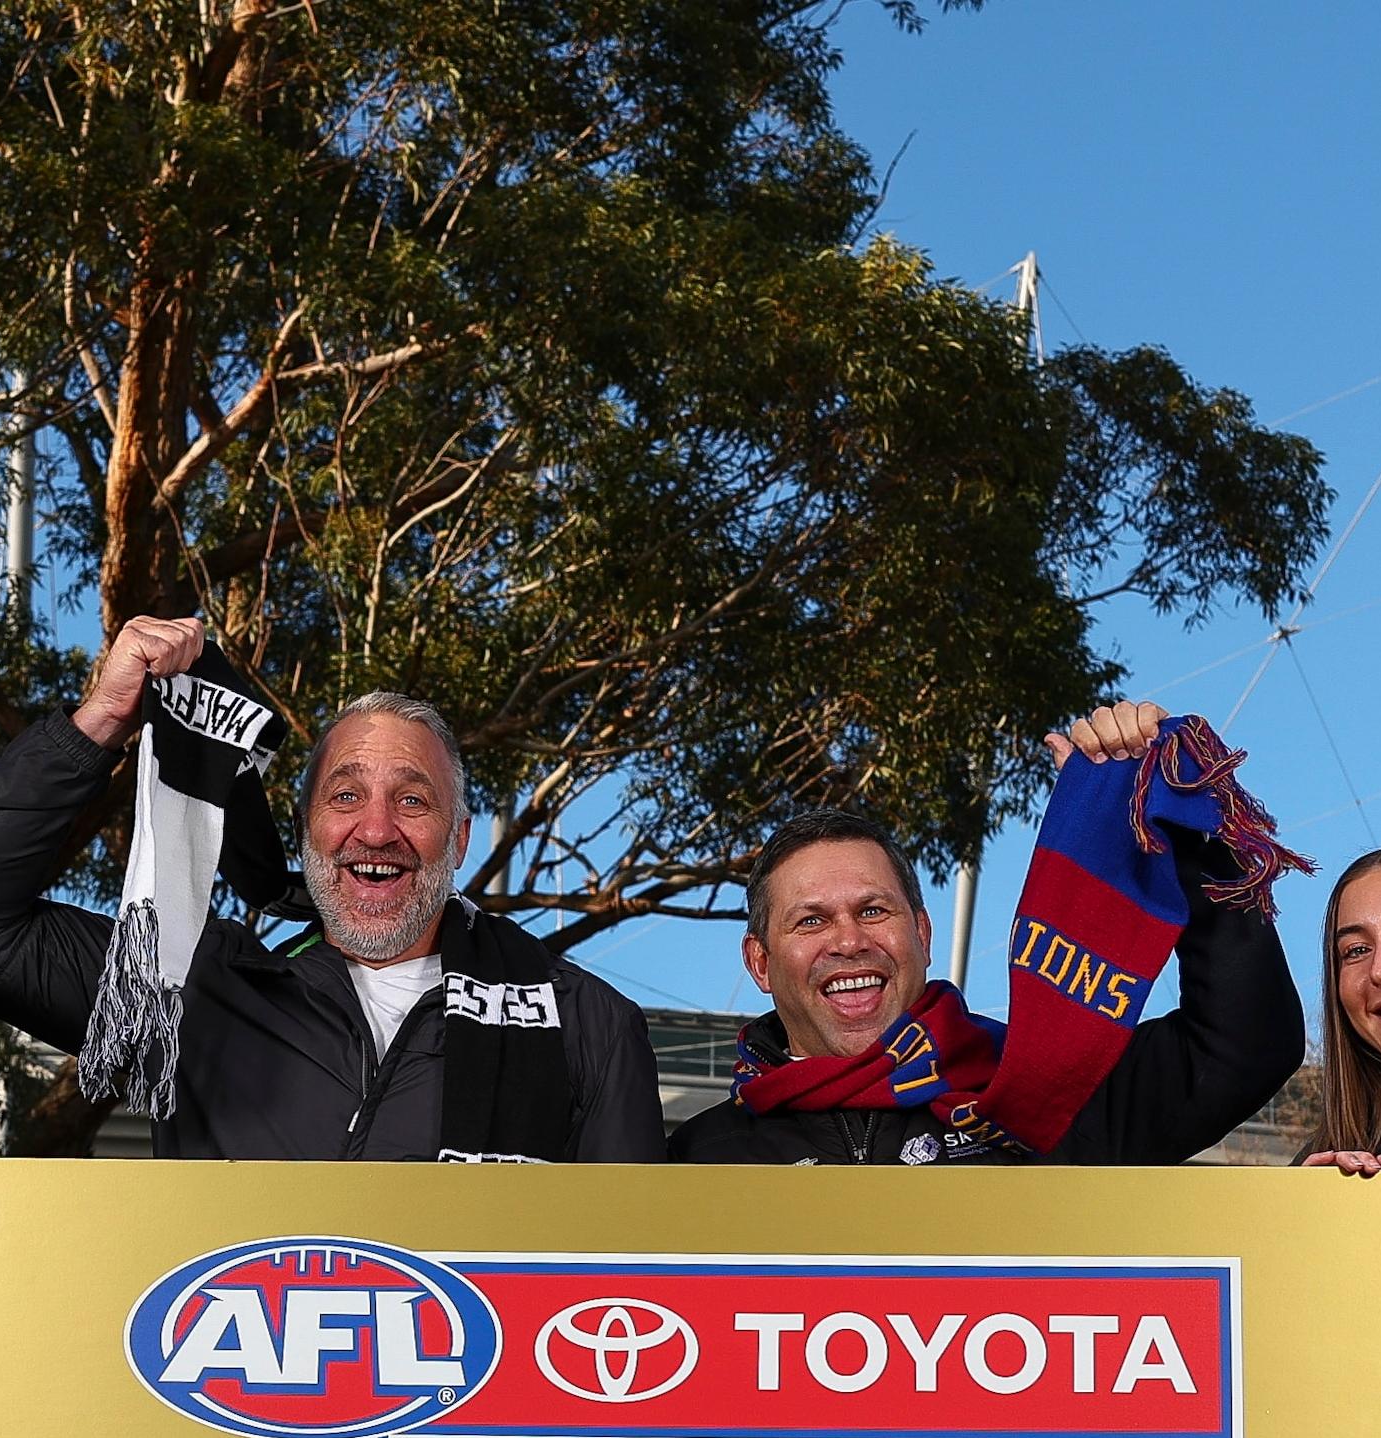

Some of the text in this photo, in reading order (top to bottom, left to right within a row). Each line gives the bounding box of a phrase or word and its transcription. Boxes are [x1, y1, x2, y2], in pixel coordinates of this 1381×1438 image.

[1009, 919, 1138, 1019] IONS
[158, 1289, 1198, 1395] AFL TOYOTA
